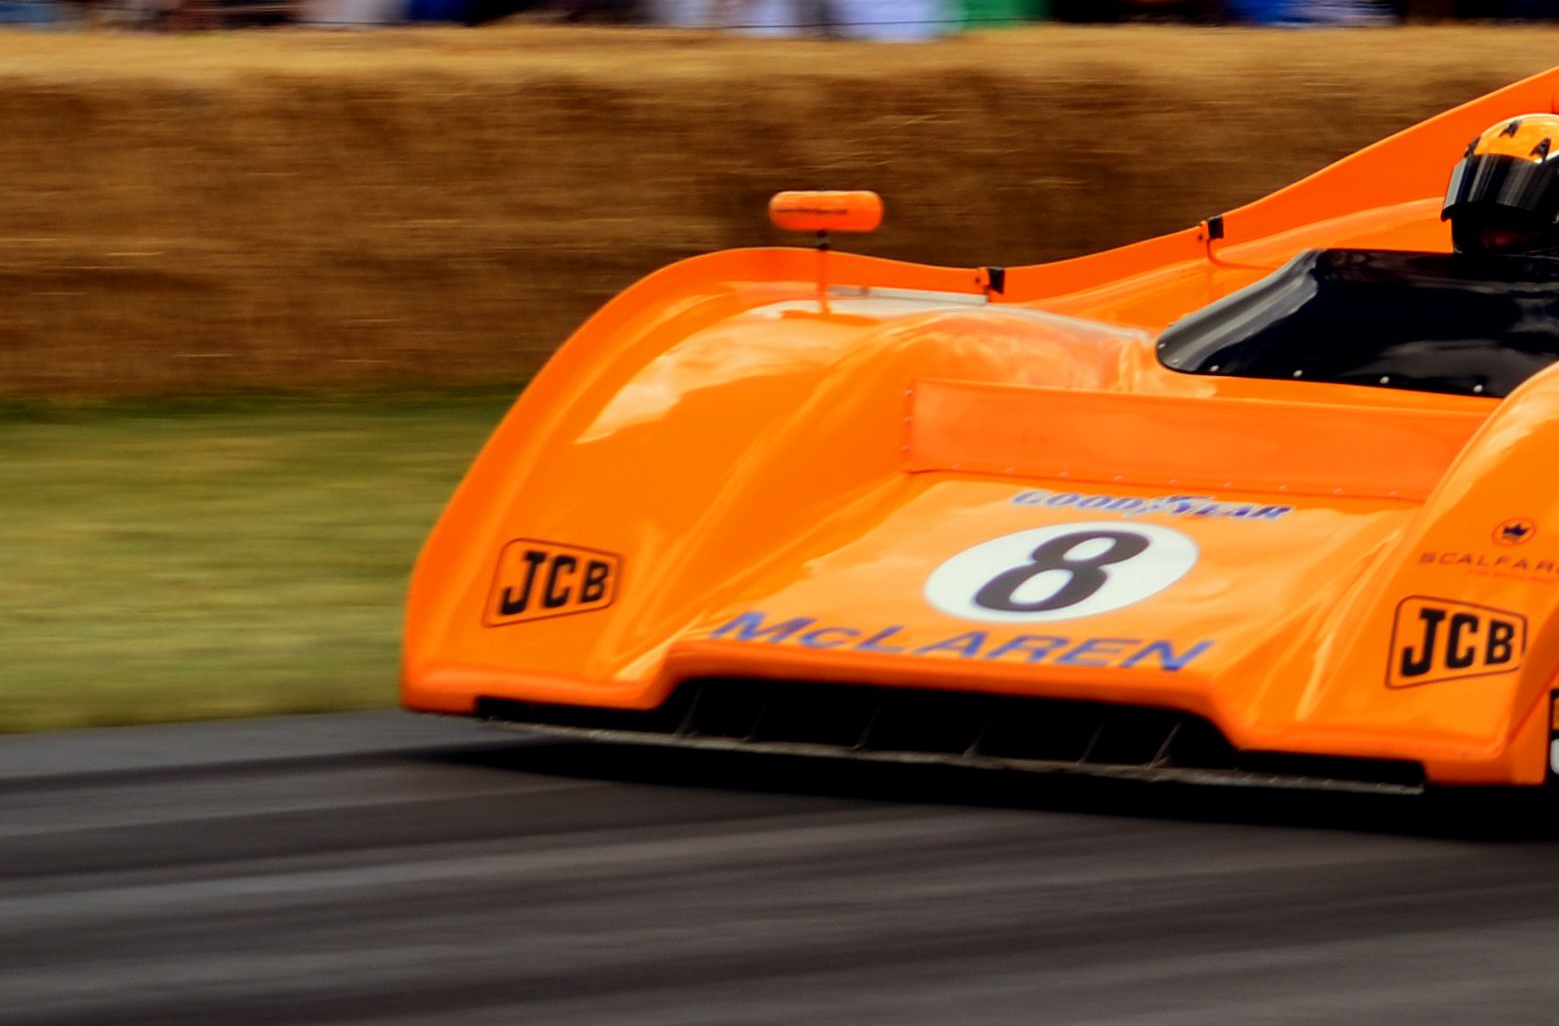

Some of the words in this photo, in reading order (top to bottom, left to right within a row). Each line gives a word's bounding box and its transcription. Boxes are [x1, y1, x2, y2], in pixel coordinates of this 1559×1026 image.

[497, 550, 611, 616] JCB
[968, 529, 1151, 613] 8
[1399, 607, 1515, 678] JCB
